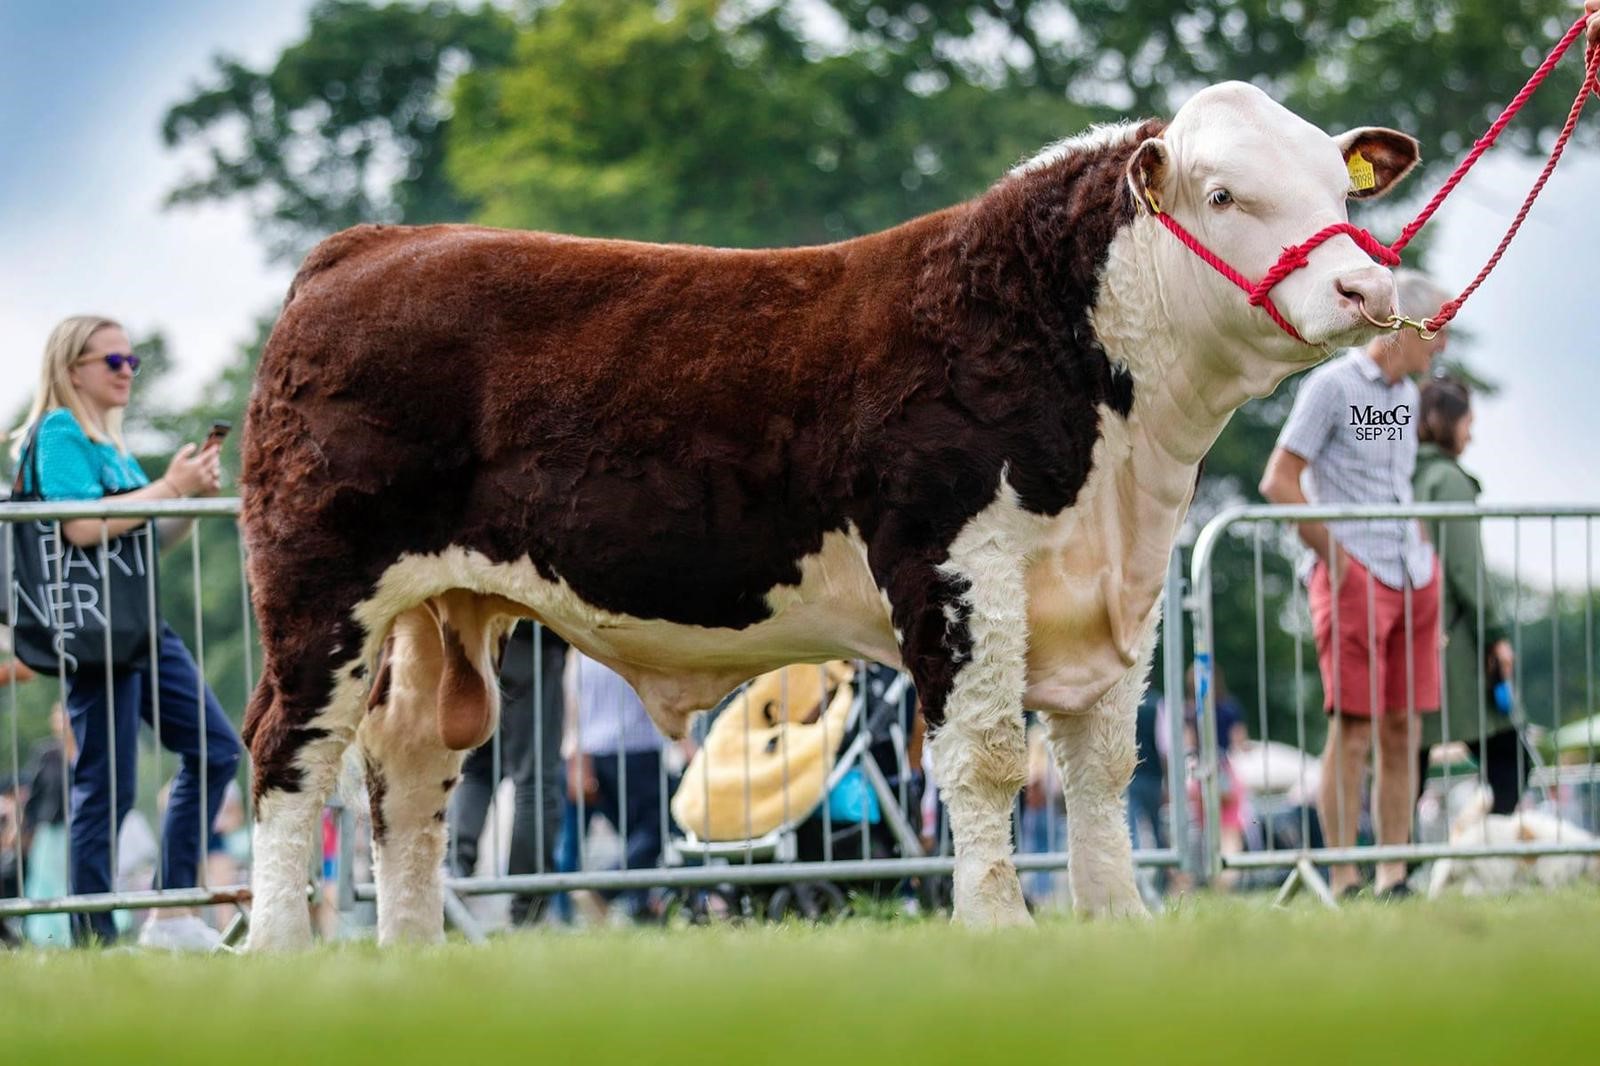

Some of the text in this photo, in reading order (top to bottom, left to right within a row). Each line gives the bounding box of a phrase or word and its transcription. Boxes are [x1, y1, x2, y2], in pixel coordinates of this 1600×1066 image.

[37, 530, 148, 581] PART
[12, 580, 108, 630] NER
[53, 632, 78, 673] S
